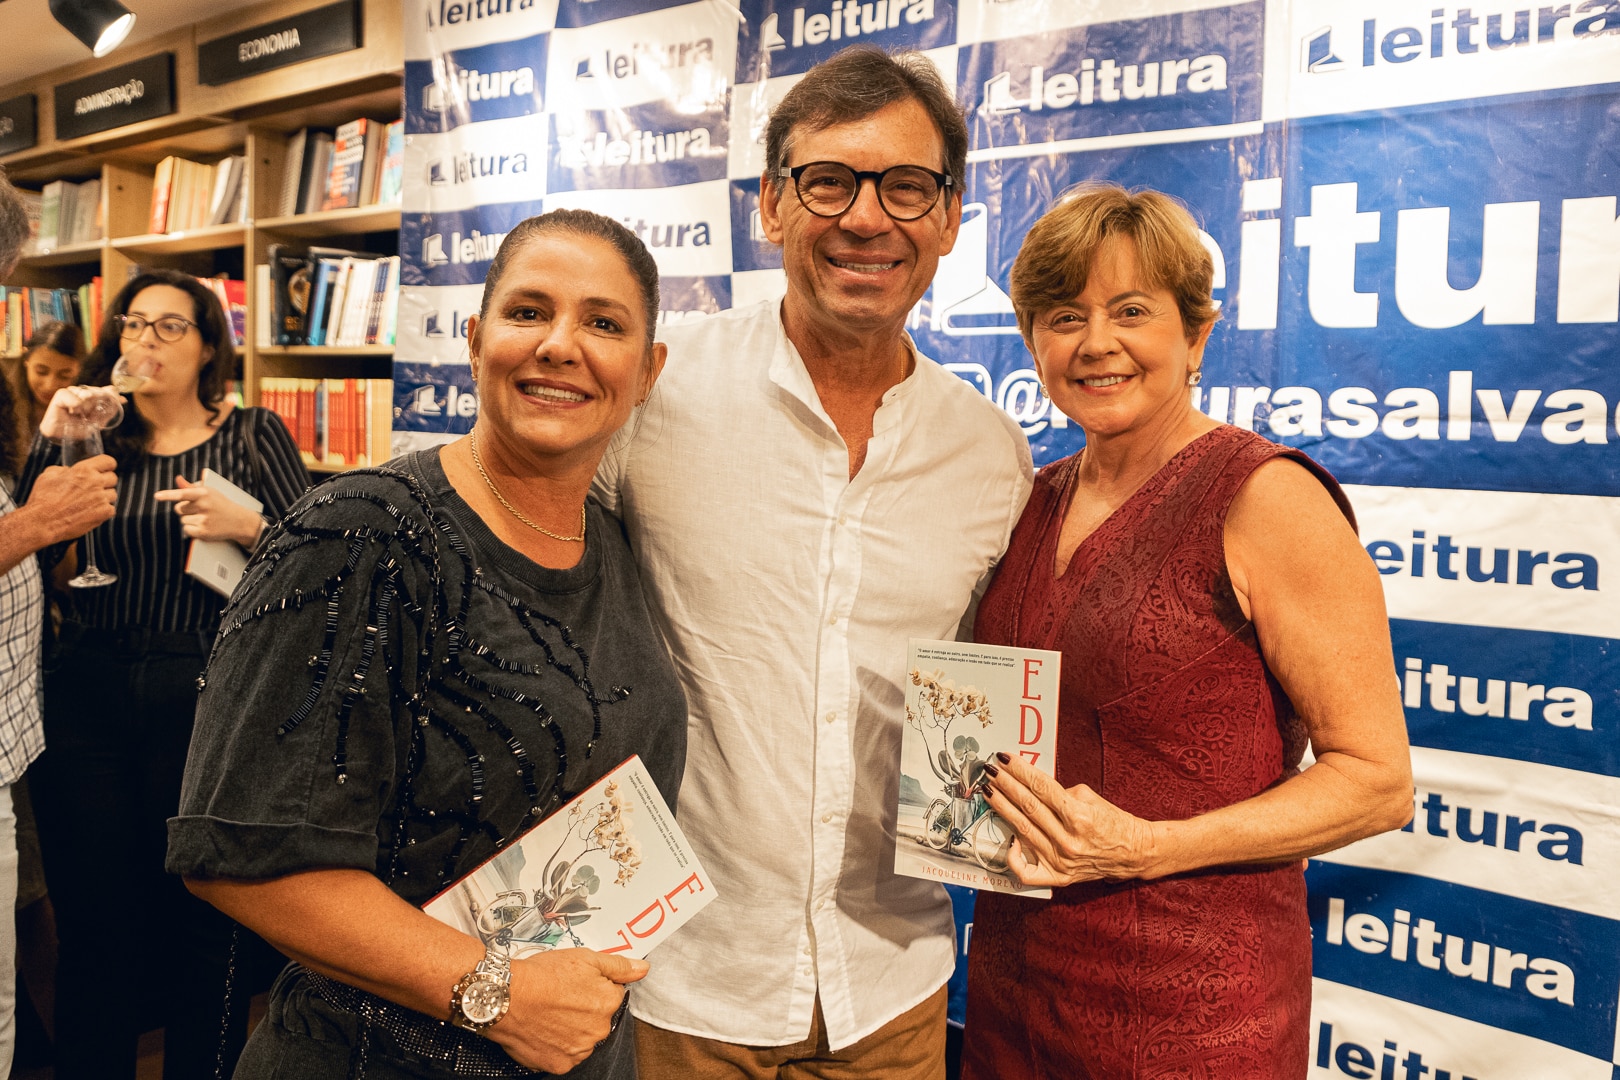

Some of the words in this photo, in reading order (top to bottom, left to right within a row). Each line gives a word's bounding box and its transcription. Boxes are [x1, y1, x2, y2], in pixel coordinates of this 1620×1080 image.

[239, 27, 301, 63] ECONOMIA
[791, 0, 935, 48] leitura
[1363, 0, 1620, 69] leitura
[75, 78, 145, 116] ADMINISTRAÇÃO
[1029, 53, 1228, 112] leitura
[591, 126, 711, 167] leitura
[1365, 528, 1601, 591] eitura
[1396, 656, 1594, 732] itura
[1401, 787, 1584, 867] tura
[921, 865, 978, 883] JACQUELINE
[982, 875, 1023, 891] MORENO
[1325, 896, 1576, 1008] leitura
[1316, 1020, 1480, 1080] leit
